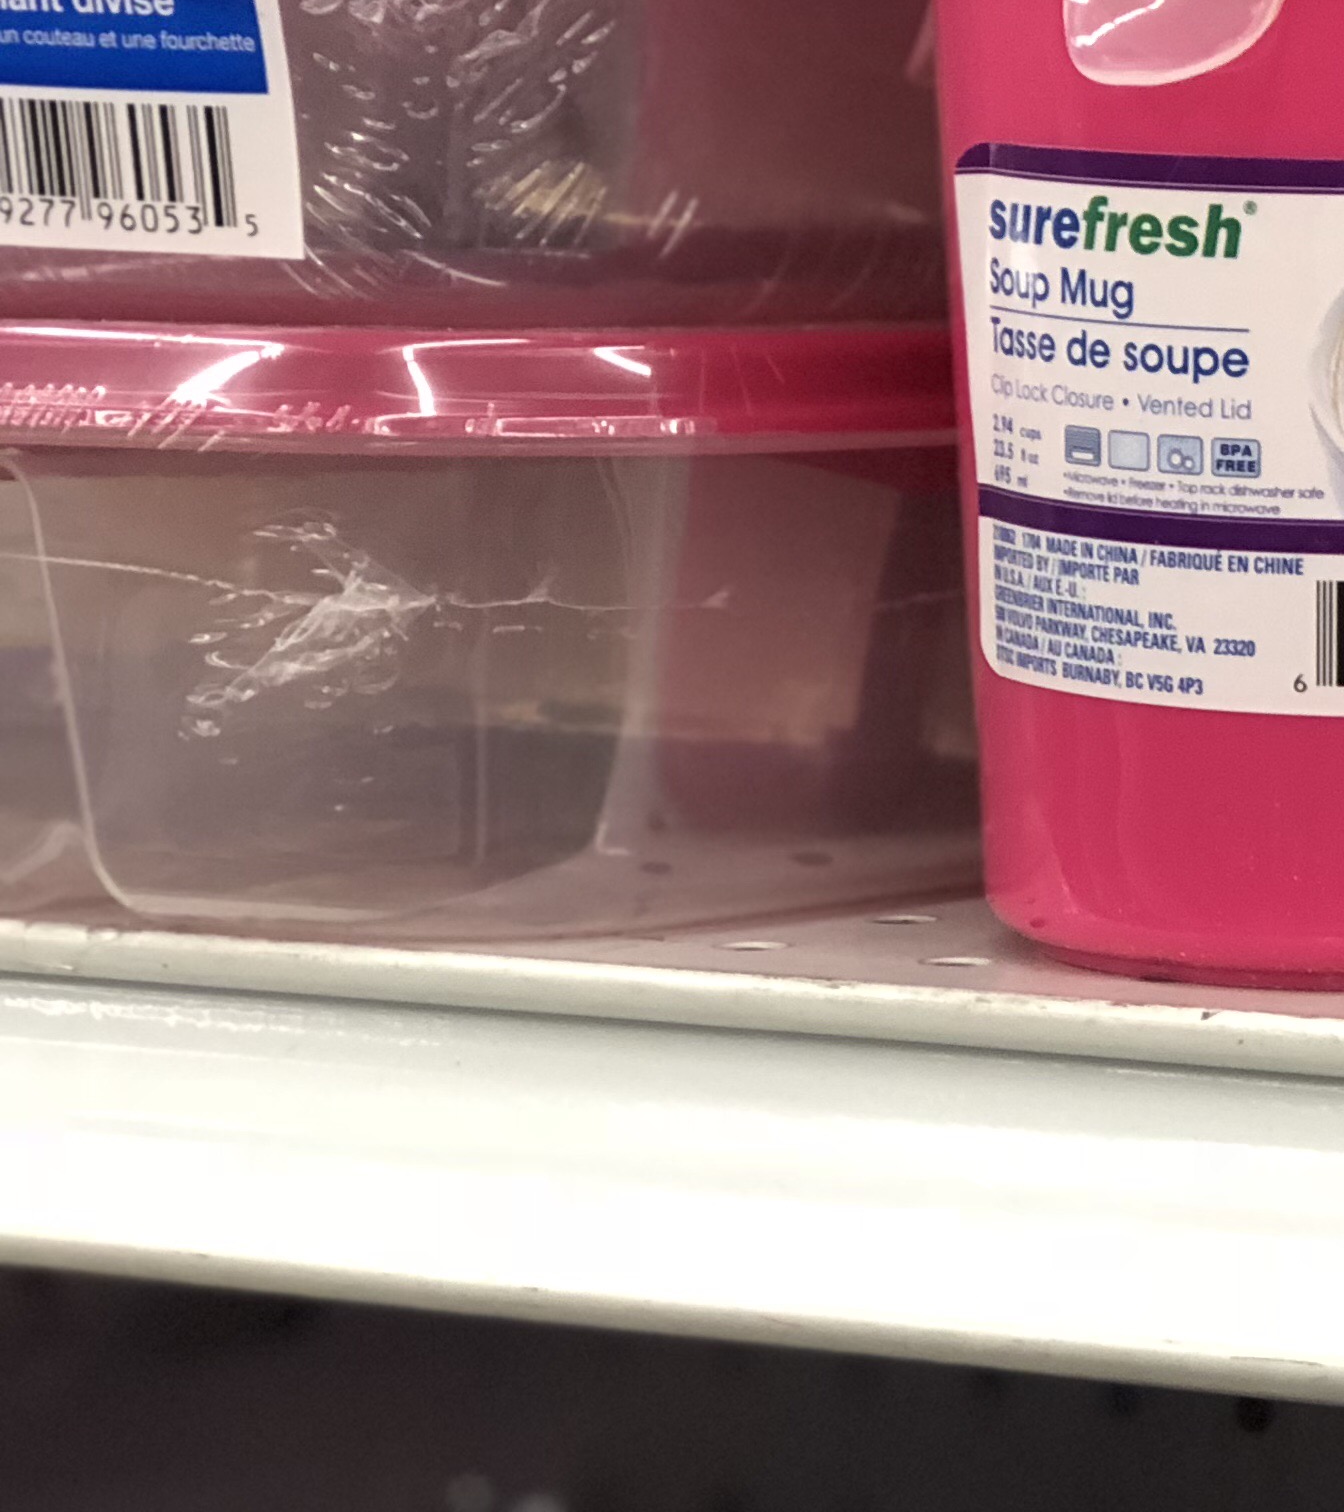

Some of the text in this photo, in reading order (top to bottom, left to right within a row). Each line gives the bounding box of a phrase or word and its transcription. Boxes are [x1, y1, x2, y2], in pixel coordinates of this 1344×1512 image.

[23, 29, 95, 47] couteau
[98, 30, 117, 48] et
[122, 32, 156, 50] une
[161, 30, 256, 52] fourchette
[97, 201, 203, 234] 96053
[246, 214, 259, 237] 5
[989, 257, 1134, 319] Soup Mug
[989, 316, 1249, 383] Tasse de soupe
[1016, 379, 1048, 402] Lock
[1052, 384, 1114, 410] Closure
[1136, 393, 1213, 418] Vented
[1221, 398, 1252, 420] Lid
[1220, 443, 1252, 457] BPA
[1215, 458, 1256, 473] FREE
[1081, 542, 1094, 559] IN
[1097, 544, 1138, 564] CHINA
[1228, 554, 1249, 573] EN
[1254, 556, 1304, 576] CHINE
[1113, 566, 1139, 585] PAR
[1148, 611, 1177, 631] INC.
[1065, 641, 1115, 665] CANADA
[1186, 636, 1206, 654] VA
[1213, 638, 1257, 658] 23320
[1125, 671, 1144, 690] BC
[1147, 673, 1174, 693] V5G
[1177, 677, 1204, 696] 4P3
[1293, 673, 1308, 693] 6
